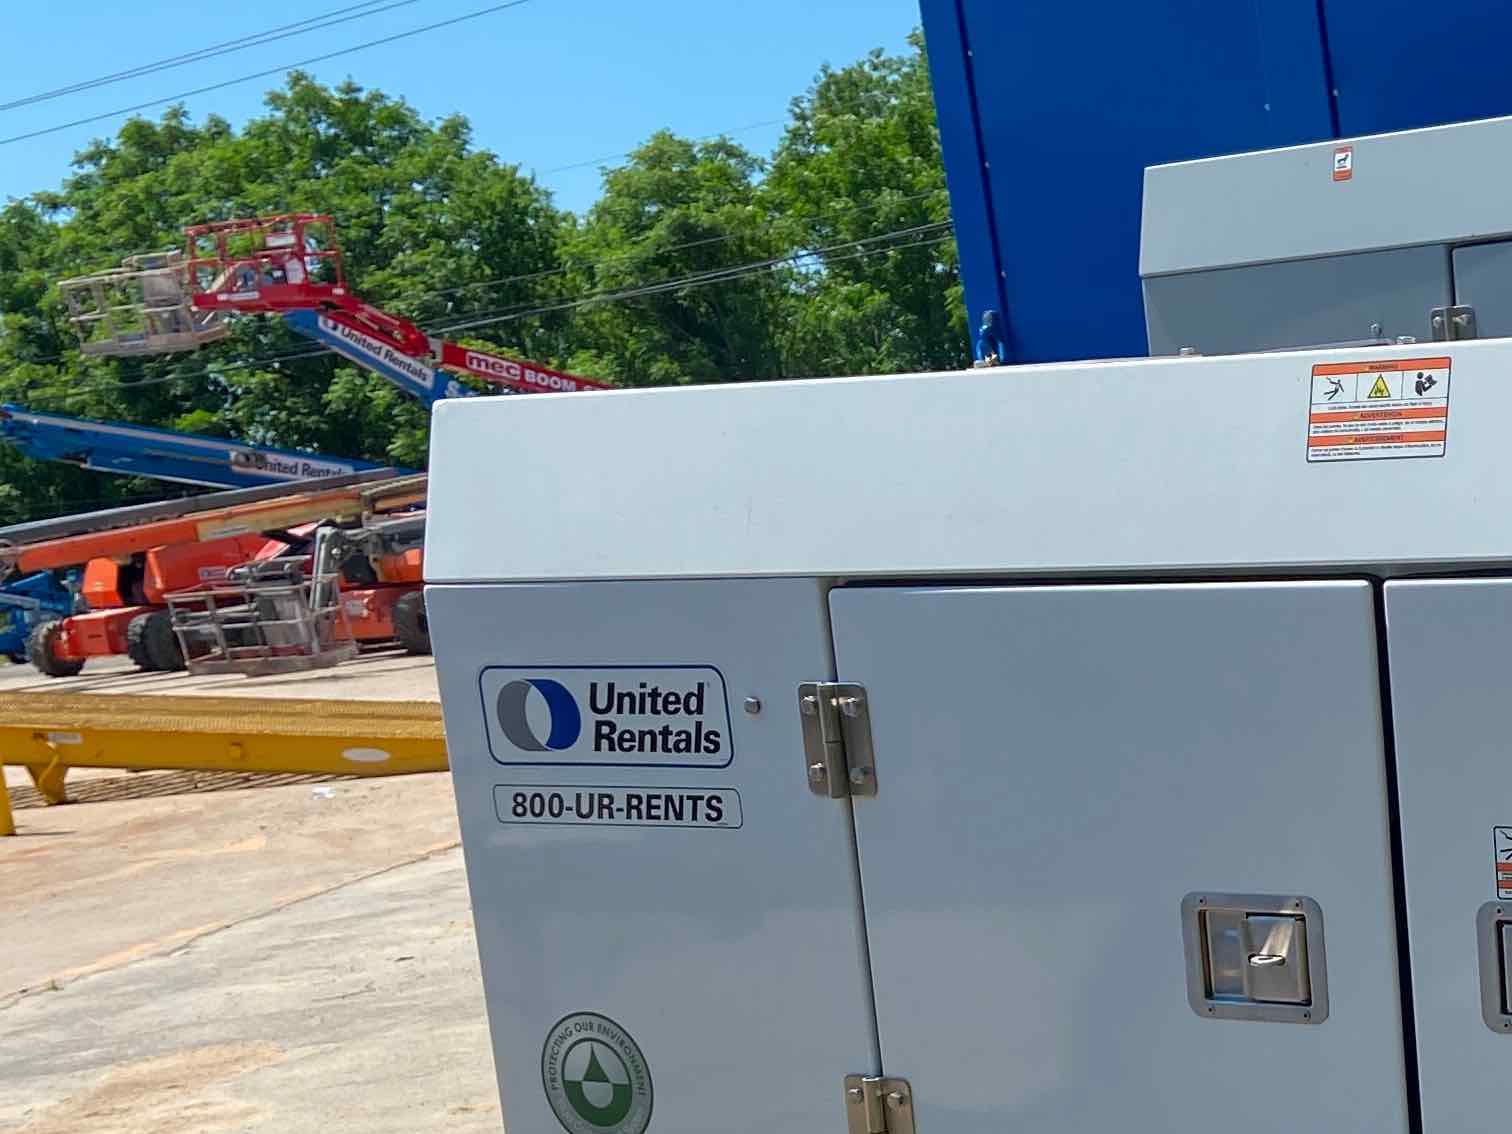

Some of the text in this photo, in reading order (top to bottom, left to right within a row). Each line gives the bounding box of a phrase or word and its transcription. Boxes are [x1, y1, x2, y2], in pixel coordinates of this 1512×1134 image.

[341, 326, 427, 381] United Rentals
[524, 368, 576, 391] BOOM
[589, 682, 705, 716] United
[594, 720, 721, 754] Rentals
[511, 792, 723, 822] 800-UR-RENTS
